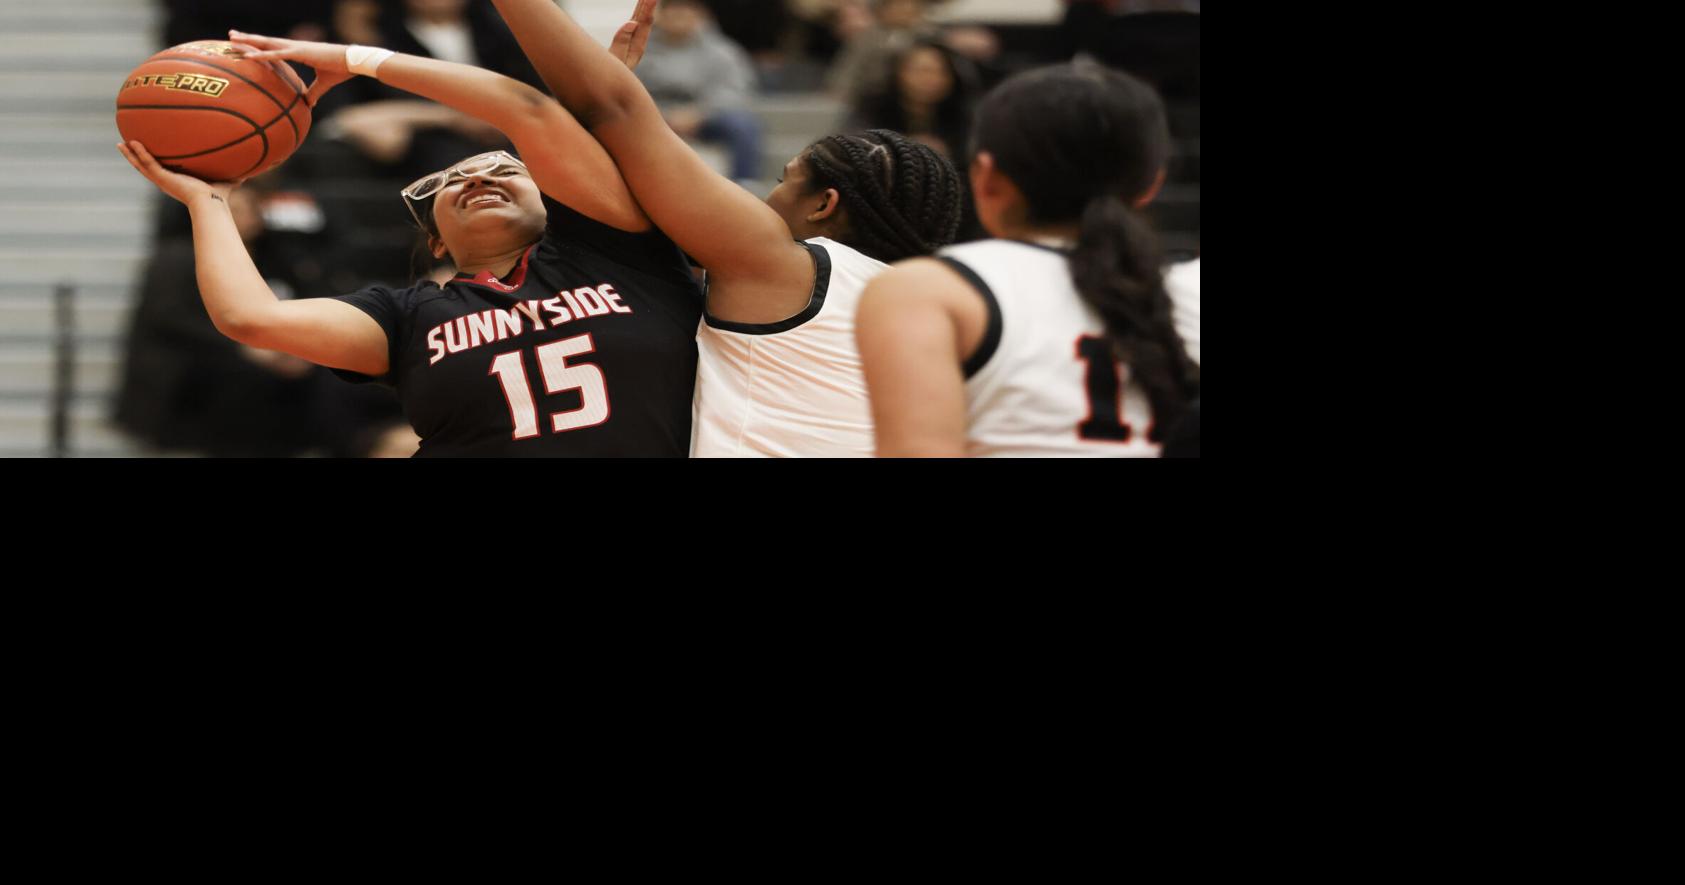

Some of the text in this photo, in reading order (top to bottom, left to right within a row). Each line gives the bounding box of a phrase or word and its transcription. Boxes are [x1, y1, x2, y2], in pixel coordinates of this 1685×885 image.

[176, 75, 225, 95] PRO
[427, 282, 633, 366] SUNNYSIDE
[488, 332, 611, 440] 15
[1074, 333, 1163, 444] 1
